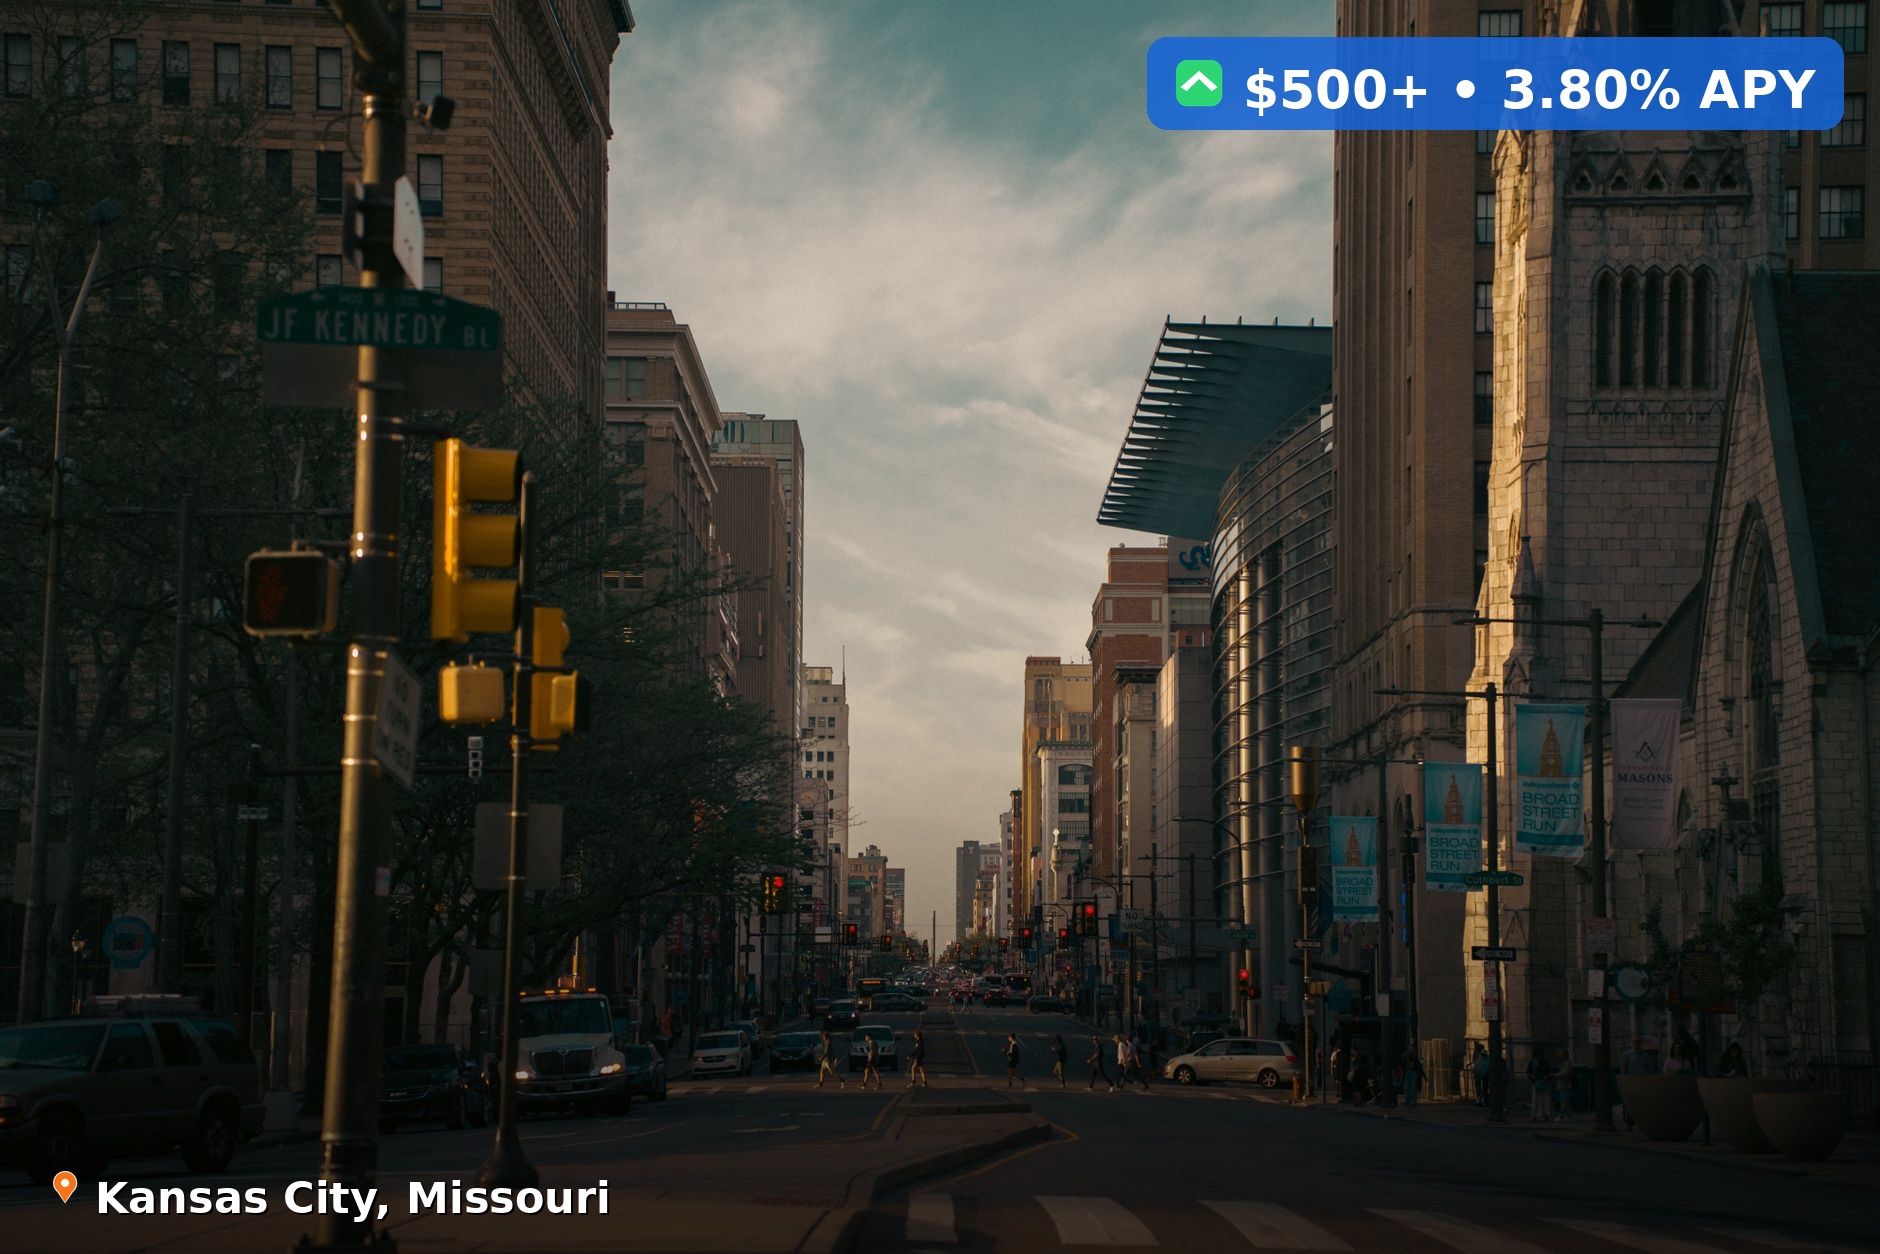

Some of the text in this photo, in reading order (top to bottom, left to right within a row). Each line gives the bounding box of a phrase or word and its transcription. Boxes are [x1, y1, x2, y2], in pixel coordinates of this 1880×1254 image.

[264, 306, 490, 349] JF KENNEDY BL
[1618, 772, 1673, 783] MASONS
[1522, 791, 1580, 805] BROAD
[1522, 805, 1580, 819] STREET
[1523, 818, 1557, 832] RUN
[1430, 837, 1480, 848] BROAD
[1430, 849, 1480, 859] STREET
[1430, 860, 1460, 871] RUN
[1335, 877, 1374, 886] BROAD
[1335, 886, 1374, 896] STREET
[1336, 896, 1360, 905] RUN
[1125, 912, 1138, 920] NO
[1186, 999, 1199, 1008] 25
